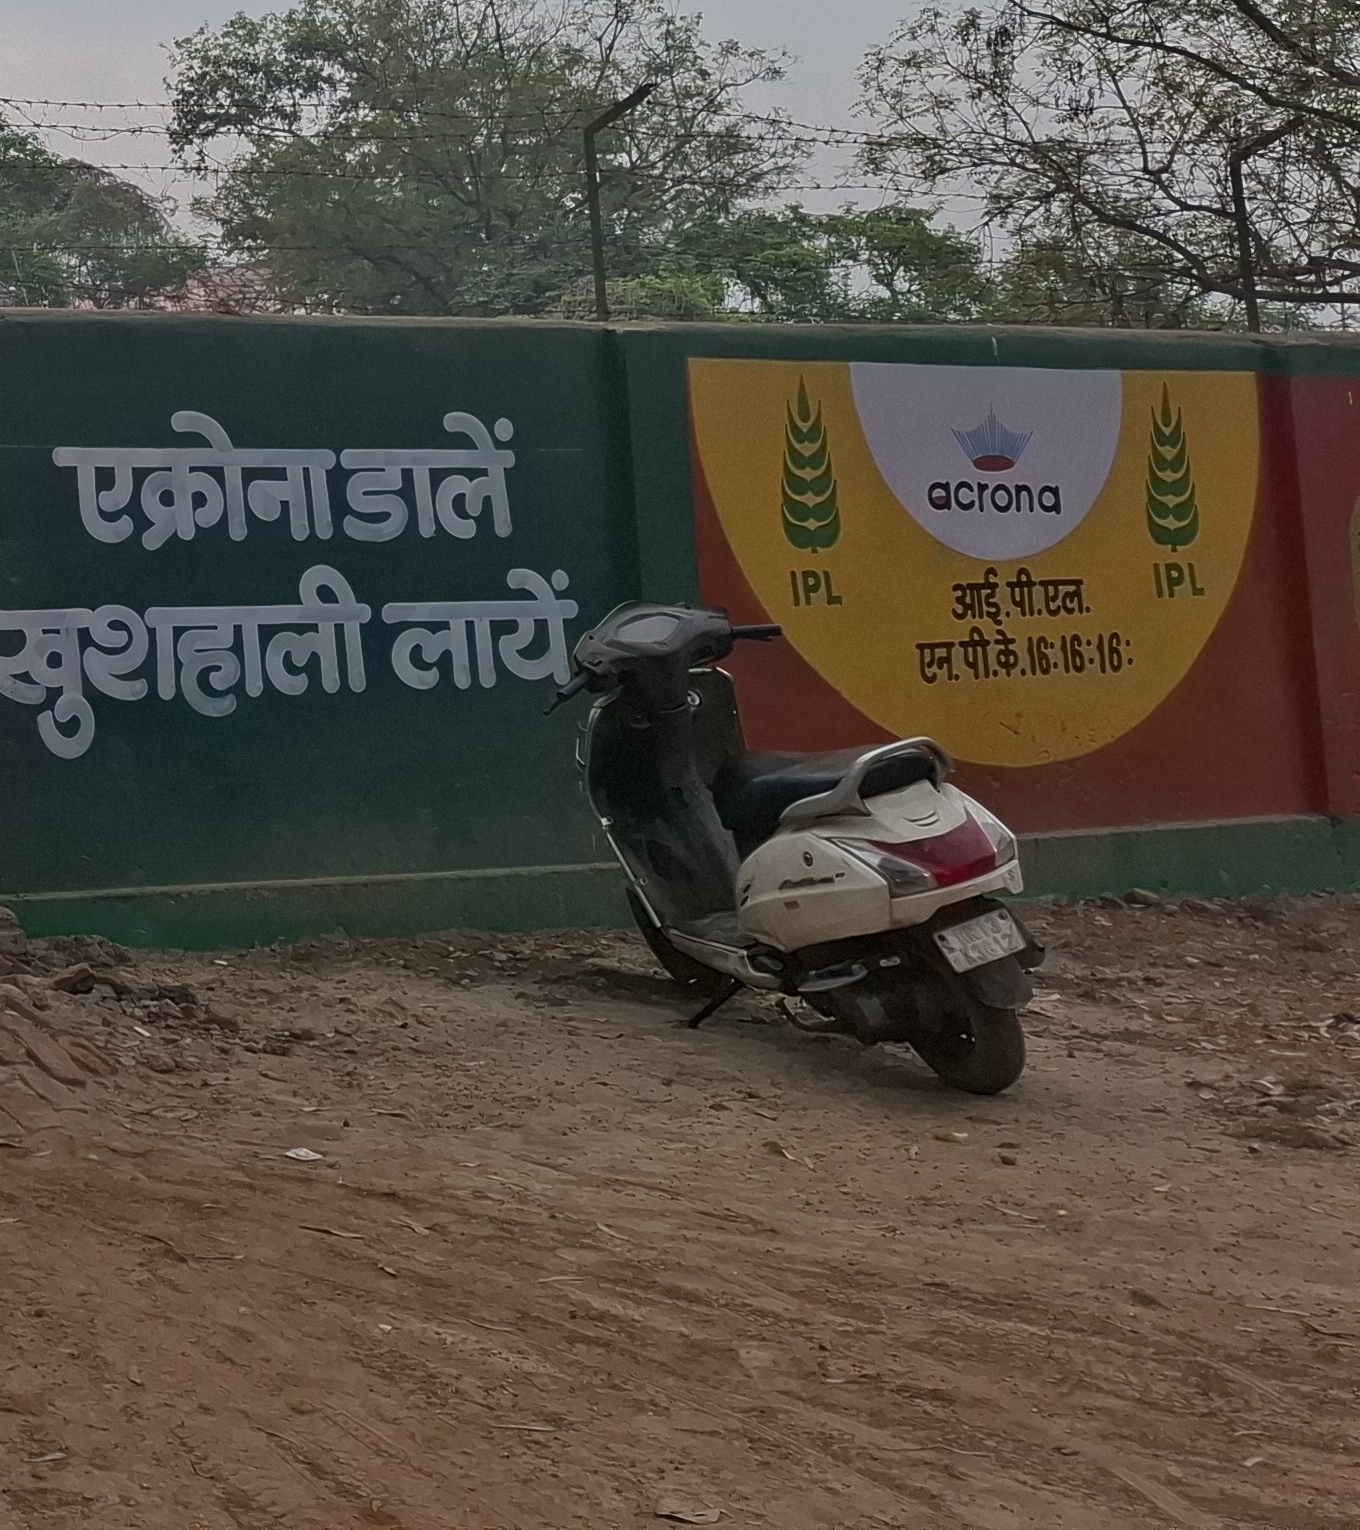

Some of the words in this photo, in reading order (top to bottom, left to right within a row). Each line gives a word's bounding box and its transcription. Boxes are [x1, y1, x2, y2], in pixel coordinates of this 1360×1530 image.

[340, 411, 516, 542] डालें
[927, 479, 1062, 516] acrona
[790, 570, 843, 608] IPL
[951, 566, 1091, 626] आई.पी.एल.
[1152, 562, 1206, 599] IPL
[381, 568, 578, 690] लायें
